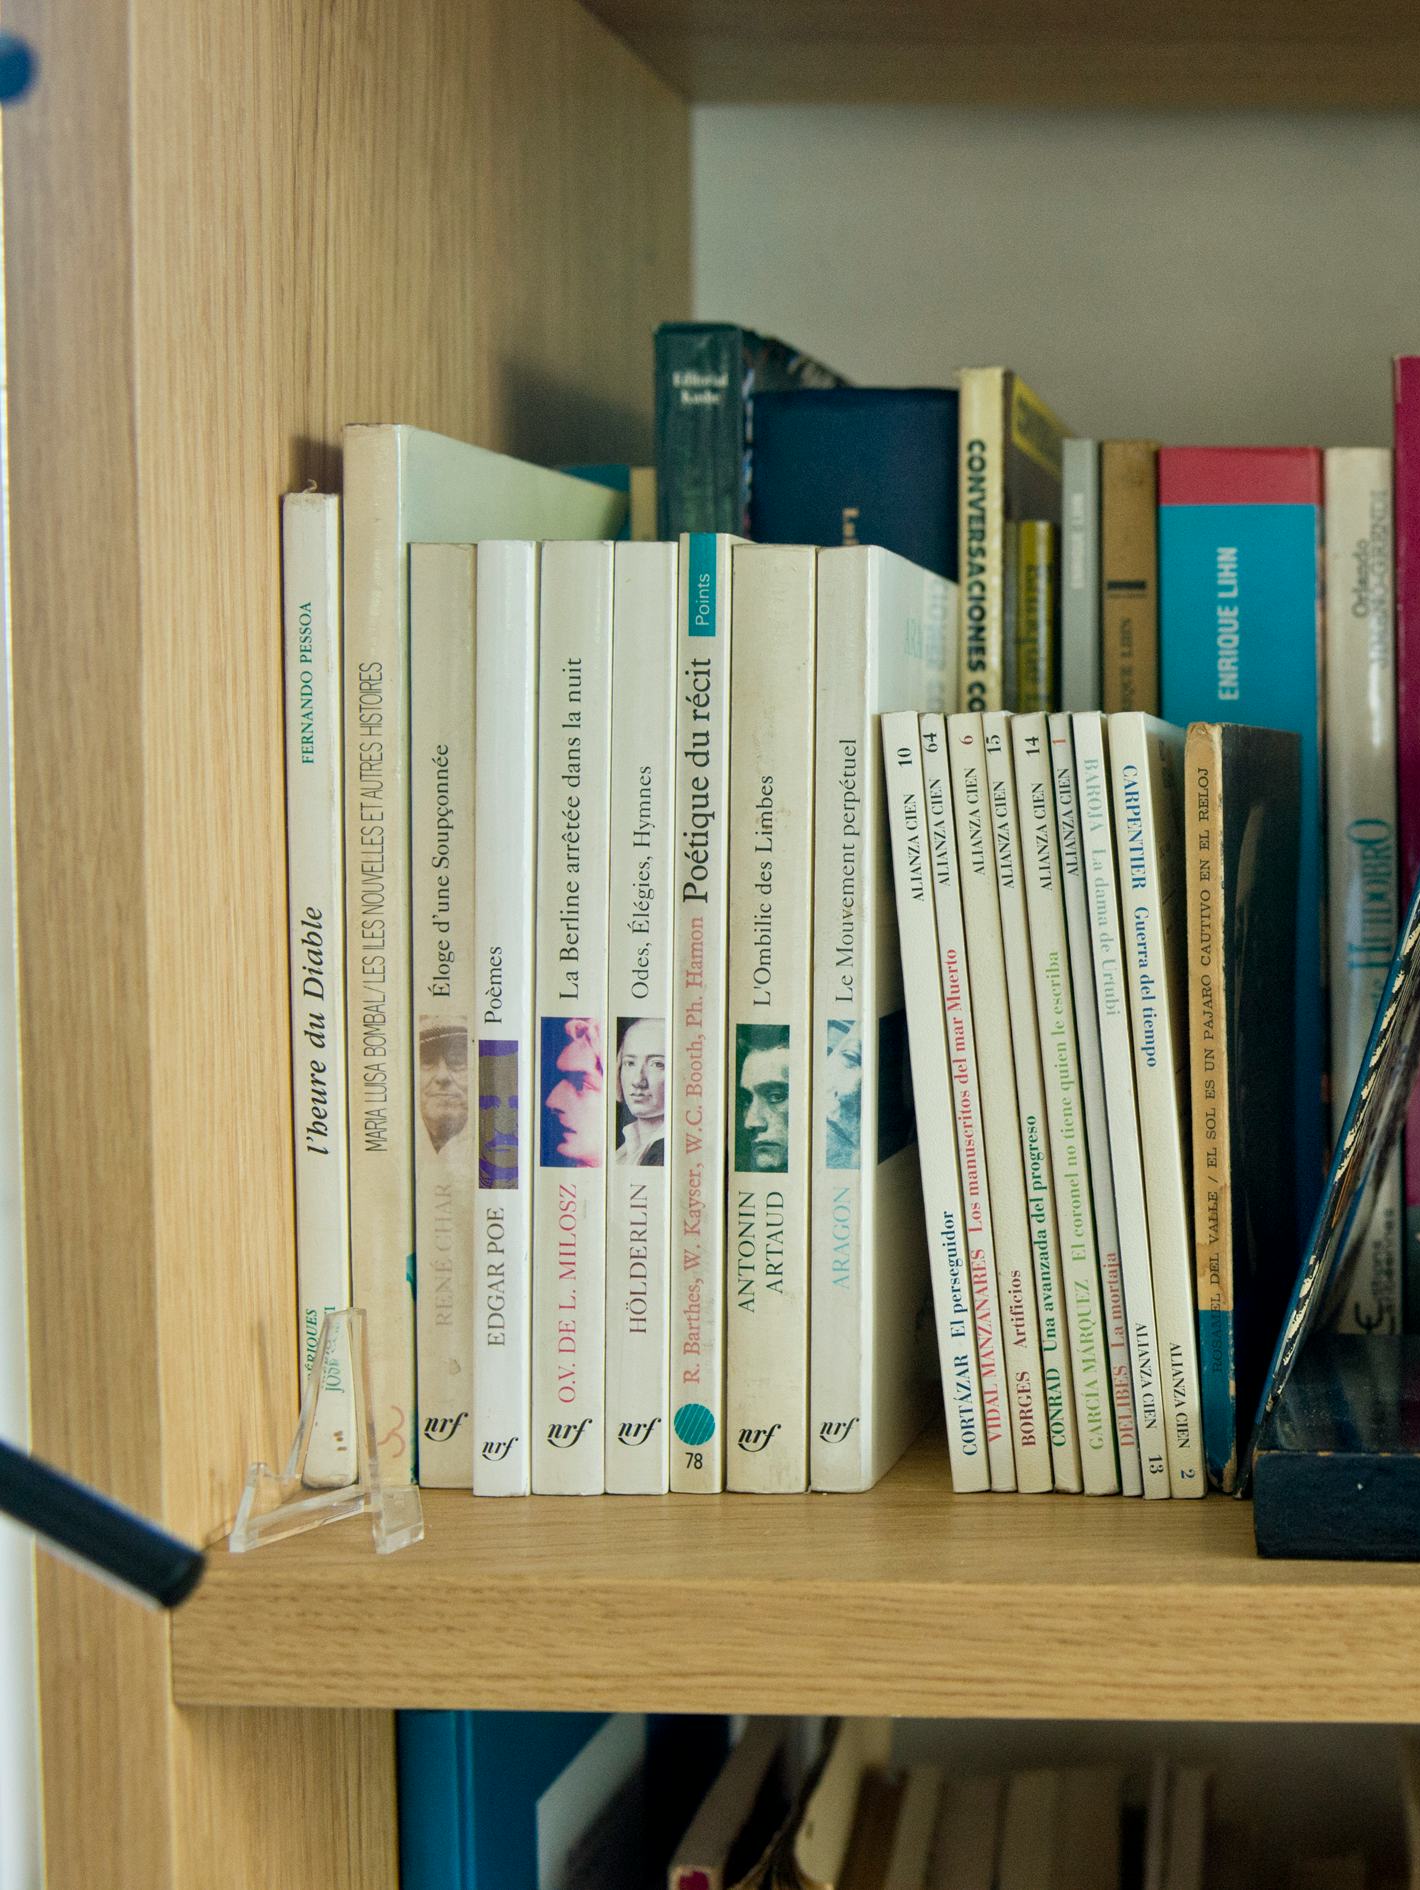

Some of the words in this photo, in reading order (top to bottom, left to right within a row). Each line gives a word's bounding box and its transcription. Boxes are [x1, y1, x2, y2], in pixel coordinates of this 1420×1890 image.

[966, 439, 987, 672] CONVERSACIONES
[1216, 547, 1238, 598] LIHN
[1351, 539, 1370, 617] Orlando
[695, 573, 712, 626] Points
[299, 601, 313, 664] PESSOA
[1217, 606, 1240, 700] ENRIQUE
[358, 662, 383, 736] HISTOIRES
[563, 657, 583, 703] nuit
[684, 657, 712, 722] récit
[300, 671, 314, 764] FERNANDO
[562, 711, 583, 730] la
[923, 732, 939, 753] 64
[959, 735, 975, 745] 6
[986, 734, 1002, 754] 15
[1024, 736, 1040, 757] 14
[359, 741, 384, 800] AUTRES
[562, 736, 582, 788] dans
[683, 729, 711, 767] du
[897, 748, 913, 768] 10
[431, 744, 454, 869] Soupçonnée
[633, 765, 655, 848] Hymnes
[754, 775, 774, 853] Limbes
[837, 738, 861, 837] perpétuel
[903, 793, 918, 830] CIEN
[928, 778, 944, 815] CIEN
[964, 768, 979, 804] CIEN
[991, 780, 1008, 817] CIEN
[1030, 782, 1047, 819] CIEN
[1056, 768, 1072, 805] CIEN
[1083, 758, 1105, 832] BAROJA
[1197, 768, 1210, 821] RELOJ
[560, 796, 582, 873] arrêtée
[682, 776, 716, 903] Poétique
[931, 819, 951, 886] ALIANZA
[968, 808, 986, 876] ALIANZA
[996, 822, 1015, 889] ALIANZA
[1060, 809, 1079, 877] ALIANZA
[1122, 764, 1146, 889] CARPENTIER
[1198, 829, 1210, 851] EL
[360, 826, 385, 915] NOUVELLES
[754, 861, 773, 895] des
[907, 835, 925, 902] ALIANZA
[1035, 824, 1053, 891] ALIANZA
[1088, 848, 1104, 867] La
[1199, 859, 1211, 881] EN
[560, 881, 581, 962] Berline
[628, 855, 655, 934] Élégies,
[836, 843, 857, 967] Mouvement
[1091, 877, 1108, 921] dama
[300, 906, 325, 1001] Diable
[685, 917, 703, 988] Hamon
[753, 903, 773, 1006] L'Ombilic
[1096, 933, 1110, 953] de
[1133, 906, 1151, 969] Guerra
[1199, 889, 1213, 966] CAUTIVO
[428, 939, 453, 997] Éloge
[484, 946, 503, 1024] Poèmes
[560, 969, 580, 1000] La
[631, 942, 653, 999] Odes,
[835, 973, 855, 1002] Le
[944, 948, 962, 1011] Muerto
[1045, 951, 1063, 1014] escriba
[1101, 959, 1120, 1015] Urtubi
[1138, 974, 1154, 1000] del
[304, 1013, 326, 1048] du
[685, 995, 703, 1027] Ph.
[950, 1016, 966, 1052] mar
[1050, 1019, 1066, 1035] le
[1200, 974, 1214, 1040] PAJARO
[685, 1033, 706, 1097] Booth,
[1056, 1041, 1075, 1091] quien
[1140, 1007, 1158, 1068] tiempo
[1203, 1048, 1215, 1071] UN
[362, 1061, 388, 1103] LUISA
[951, 1057, 969, 1084] del
[1204, 1079, 1215, 1098] ES
[305, 1060, 329, 1155] l'heure
[363, 1107, 388, 1152] MARIA
[685, 1104, 703, 1154] W.C.
[1059, 1097, 1076, 1139] tiene
[1204, 1107, 1217, 1139] SOL
[957, 1090, 980, 1196] manuscritos
[1024, 1115, 1048, 1191] progreso
[1065, 1144, 1078, 1167] no
[1205, 1148, 1217, 1167] EL
[434, 1183, 453, 1253] CHAR
[684, 1163, 707, 1235] Kayser,
[966, 1202, 984, 1232] Los
[1029, 1197, 1046, 1223] del
[1065, 1172, 1085, 1237] coronel
[1207, 1191, 1219, 1244] VALLE
[486, 1207, 505, 1255] POE
[558, 1183, 576, 1281] MILOSZ
[625, 1183, 648, 1334] HÖLDERLIN
[685, 1242, 702, 1271] W.
[738, 1190, 756, 1313] ANTONIN
[765, 1190, 784, 1294] ARTAUD
[831, 1186, 851, 1290] ARAGON
[1071, 1242, 1086, 1261] El
[940, 1211, 968, 1314] perseguidor
[1033, 1229, 1055, 1311] avanzada
[1103, 1251, 1124, 1319] mortaja
[1207, 1252, 1220, 1285] DEL
[431, 1258, 453, 1327] RENÉ
[486, 1262, 506, 1347] EDGAR
[559, 1289, 576, 1309] L.
[684, 1277, 704, 1355] Barthes,
[970, 1248, 997, 1377] MANZANARES
[1008, 1270, 1028, 1348] Artificios
[559, 1320, 576, 1354] DE
[950, 1319, 966, 1337] El
[1041, 1317, 1058, 1352] Una
[1072, 1279, 1100, 1373] MÁRQUEZ
[1109, 1324, 1125, 1348] La
[1135, 1322, 1152, 1388] ALIANZA
[1209, 1293, 1223, 1373] ROSAMEL
[559, 1363, 576, 1403] O.V.
[683, 1362, 701, 1383] R.
[1169, 1342, 1187, 1408] ALIANZA
[953, 1354, 979, 1456] CORTÁZAR
[984, 1384, 1003, 1443] VIDAL
[1016, 1370, 1036, 1447] BORGES
[1045, 1368, 1067, 1447] CONRAD
[1076, 1379, 1105, 1450] GARCÍA
[1113, 1364, 1136, 1447] DELIBES
[1143, 1393, 1158, 1429] CIEN
[1175, 1412, 1190, 1448] CIEN
[685, 1452, 704, 1470] 78
[1148, 1454, 1164, 1474] 13
[1180, 1468, 1195, 1479] 2
